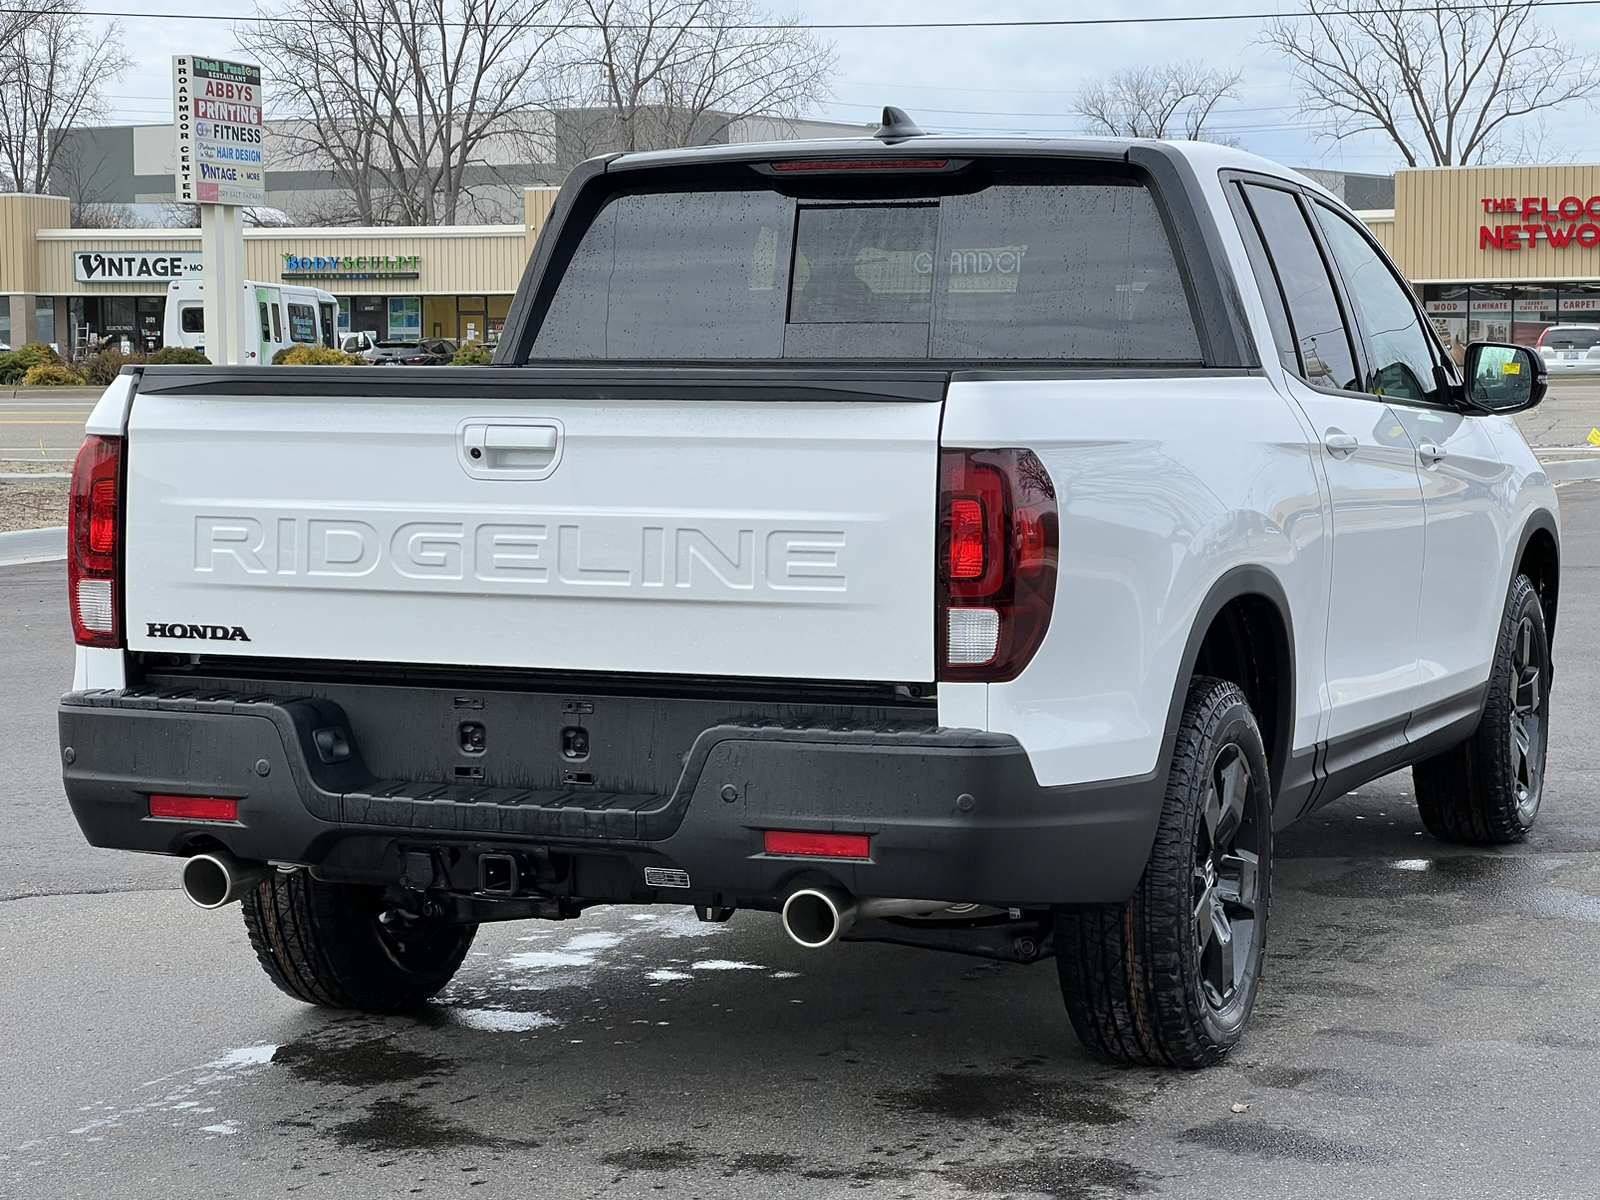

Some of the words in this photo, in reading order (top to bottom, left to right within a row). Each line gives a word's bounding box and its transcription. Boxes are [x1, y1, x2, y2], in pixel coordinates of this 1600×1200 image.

[194, 58, 219, 71] Thai
[223, 63, 259, 78] Fusion
[208, 71, 246, 82] RESTAURANT
[178, 59, 189, 139] BROADMOOR
[205, 80, 253, 102] ABBYS
[198, 100, 258, 124] PRINTING
[213, 123, 261, 144] FITNESS
[217, 146, 234, 160] HAIR
[235, 148, 261, 163] DESIGN
[180, 146, 191, 199] CENTER
[200, 163, 237, 181] VINTAGE
[246, 172, 260, 181] MORE
[1481, 198, 1517, 213] THE
[1480, 223, 1600, 250] NETWO
[78, 254, 182, 279] VINTAGE
[189, 264, 203, 272] MO
[1433, 303, 1458, 311] WOOD
[1472, 302, 1508, 310] LAMINATE
[1563, 300, 1596, 309] CARPET
[193, 514, 848, 592] RIDGELINE
[146, 622, 252, 642] HONDA
